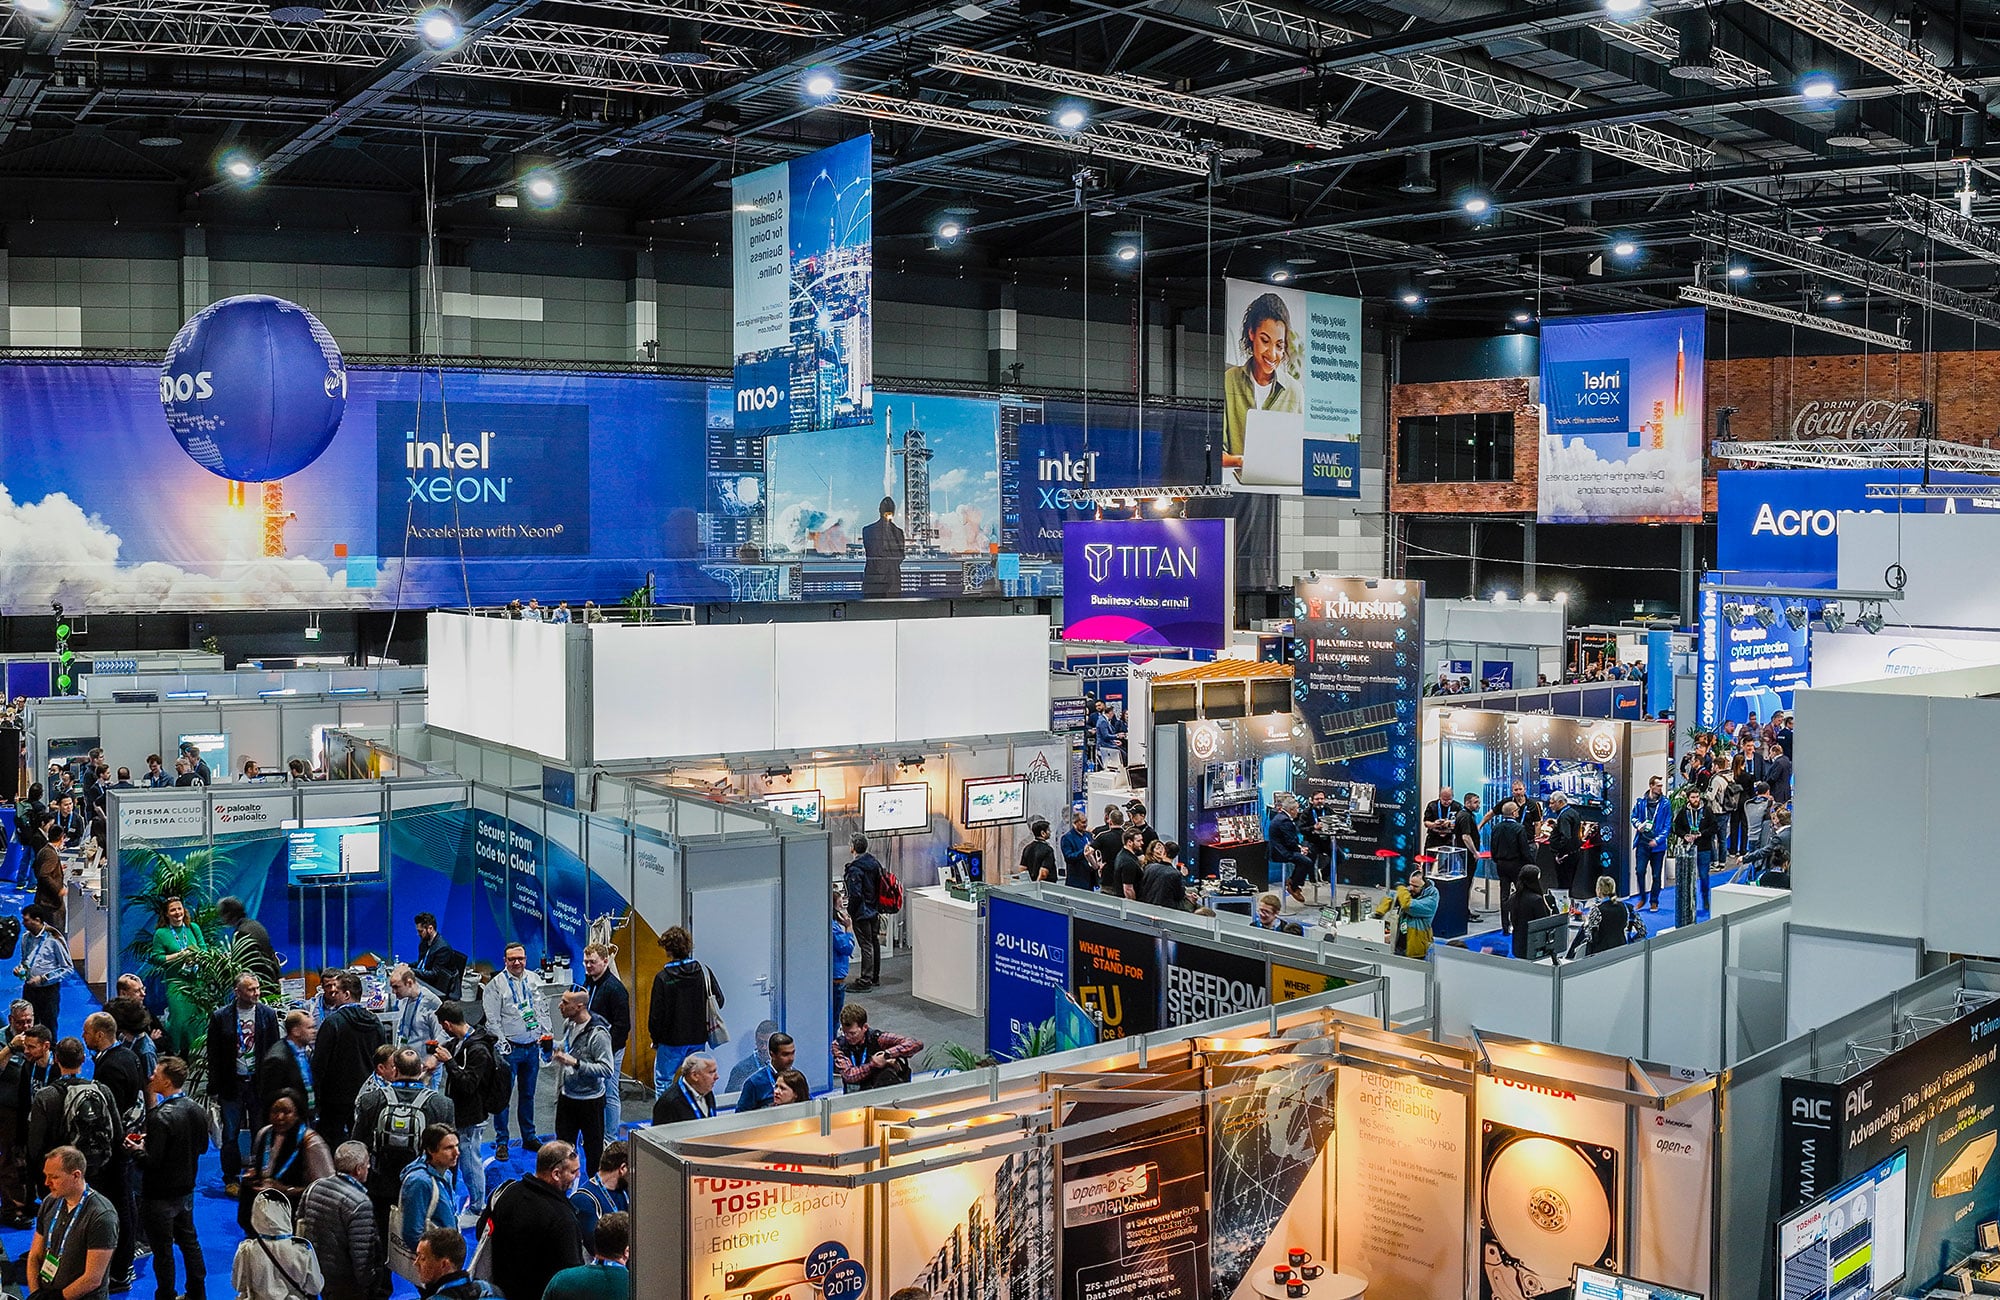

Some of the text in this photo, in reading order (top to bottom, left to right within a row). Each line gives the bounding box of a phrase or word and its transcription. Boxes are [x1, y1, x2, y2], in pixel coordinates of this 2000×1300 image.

[1823, 400, 1858, 409] DRINK
[1312, 452, 1341, 466] NAME
[1313, 465, 1352, 479] STUDIO
[1751, 503, 1886, 537] Acro
[408, 525, 483, 538] Accelerate
[486, 524, 516, 538] with
[1116, 546, 1198, 579] TITAN
[1091, 594, 1189, 609] Business-class email
[1325, 600, 1401, 619] Kingston
[1731, 640, 1789, 658] cyber protection
[1310, 682, 1320, 690] for
[227, 804, 262, 814] paloalto
[232, 813, 268, 823] paloalto
[135, 817, 176, 825] PRISMA
[478, 820, 533, 852] Secure From
[476, 840, 536, 876] Code to Cloud
[1079, 940, 1121, 961] WHAT WE
[1093, 957, 1144, 980] STAND FOR
[1167, 964, 1266, 1009] FREEDOM
[1284, 979, 1311, 993] WHERE
[1284, 990, 1296, 999] WE
[1079, 985, 1123, 1026] EU
[1117, 1026, 1125, 1038] &
[1979, 1017, 2000, 1038] Taiwa
[1361, 1070, 1434, 1100] Performance
[1844, 1080, 1873, 1121] AIC
[1849, 1043, 1998, 1150] Advancing The Next Generation of
[1360, 1092, 1442, 1125] and Reliability
[1792, 1097, 1832, 1121] AIC
[1890, 1111, 1927, 1144] Storage
[1927, 1102, 1937, 1121] &
[1936, 1081, 1976, 1114] Compute
[1359, 1130, 1457, 1152] Enterprise HDD
[1656, 1138, 1692, 1155] open-e
[694, 1191, 850, 1233] Enterprise Capacity
[1795, 1212, 1822, 1233] TOSHIBA
[818, 1249, 838, 1261] up to
[835, 1269, 855, 1282] up to
[1104, 1277, 1119, 1288] and
[827, 1277, 863, 1297] 20TB
[1086, 1273, 1175, 1300] Data Storage Software
[1168, 1287, 1182, 1297] NFS
